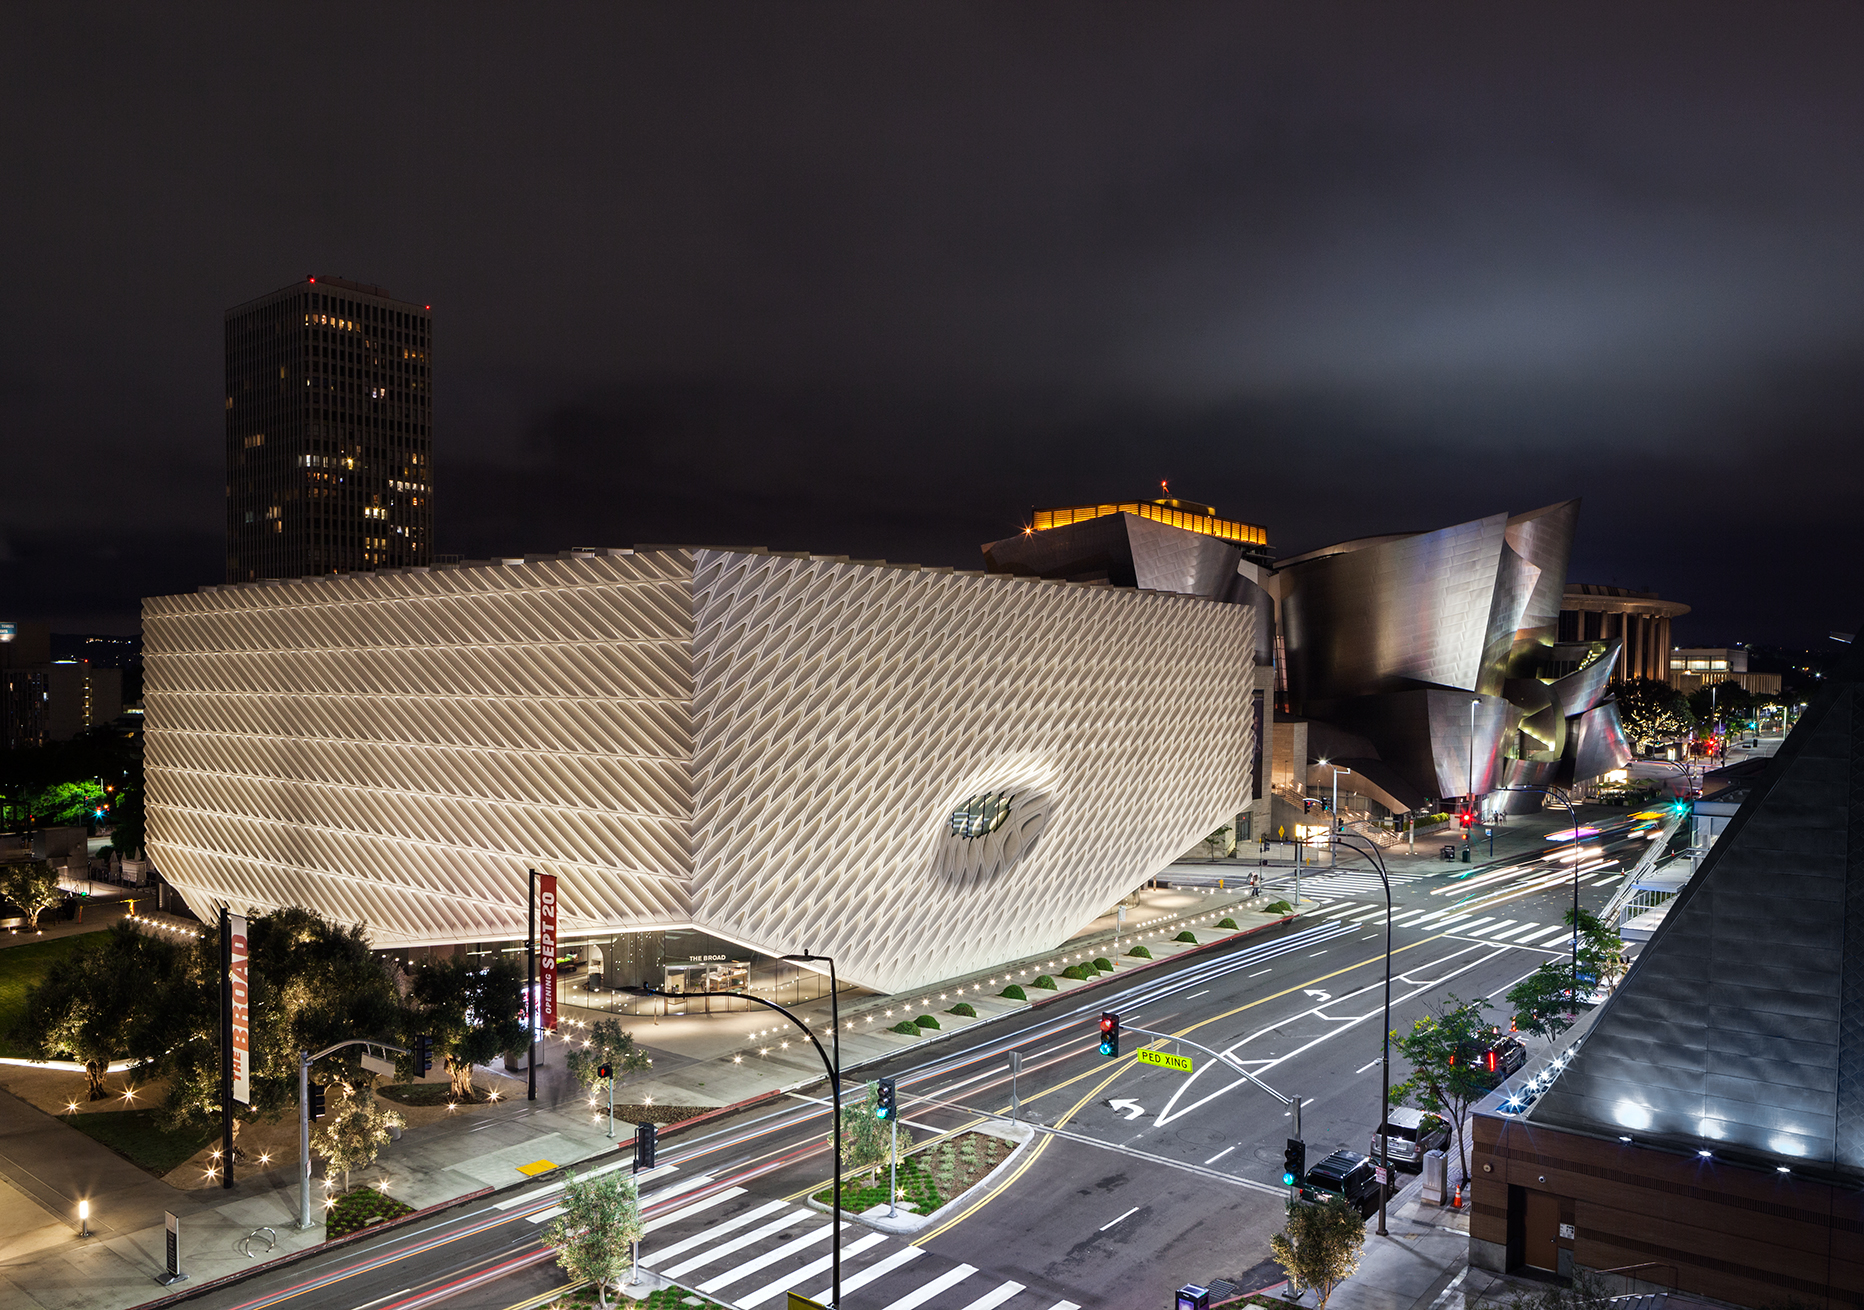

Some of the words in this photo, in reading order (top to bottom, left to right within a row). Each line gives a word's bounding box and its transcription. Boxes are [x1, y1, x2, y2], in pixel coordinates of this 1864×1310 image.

[542, 891, 555, 918] 20
[542, 921, 555, 970] SEPT
[231, 933, 249, 1052] BROAD
[233, 1051, 242, 1081] THE
[1141, 1051, 1161, 1063] PED
[1165, 1056, 1188, 1069] XING
